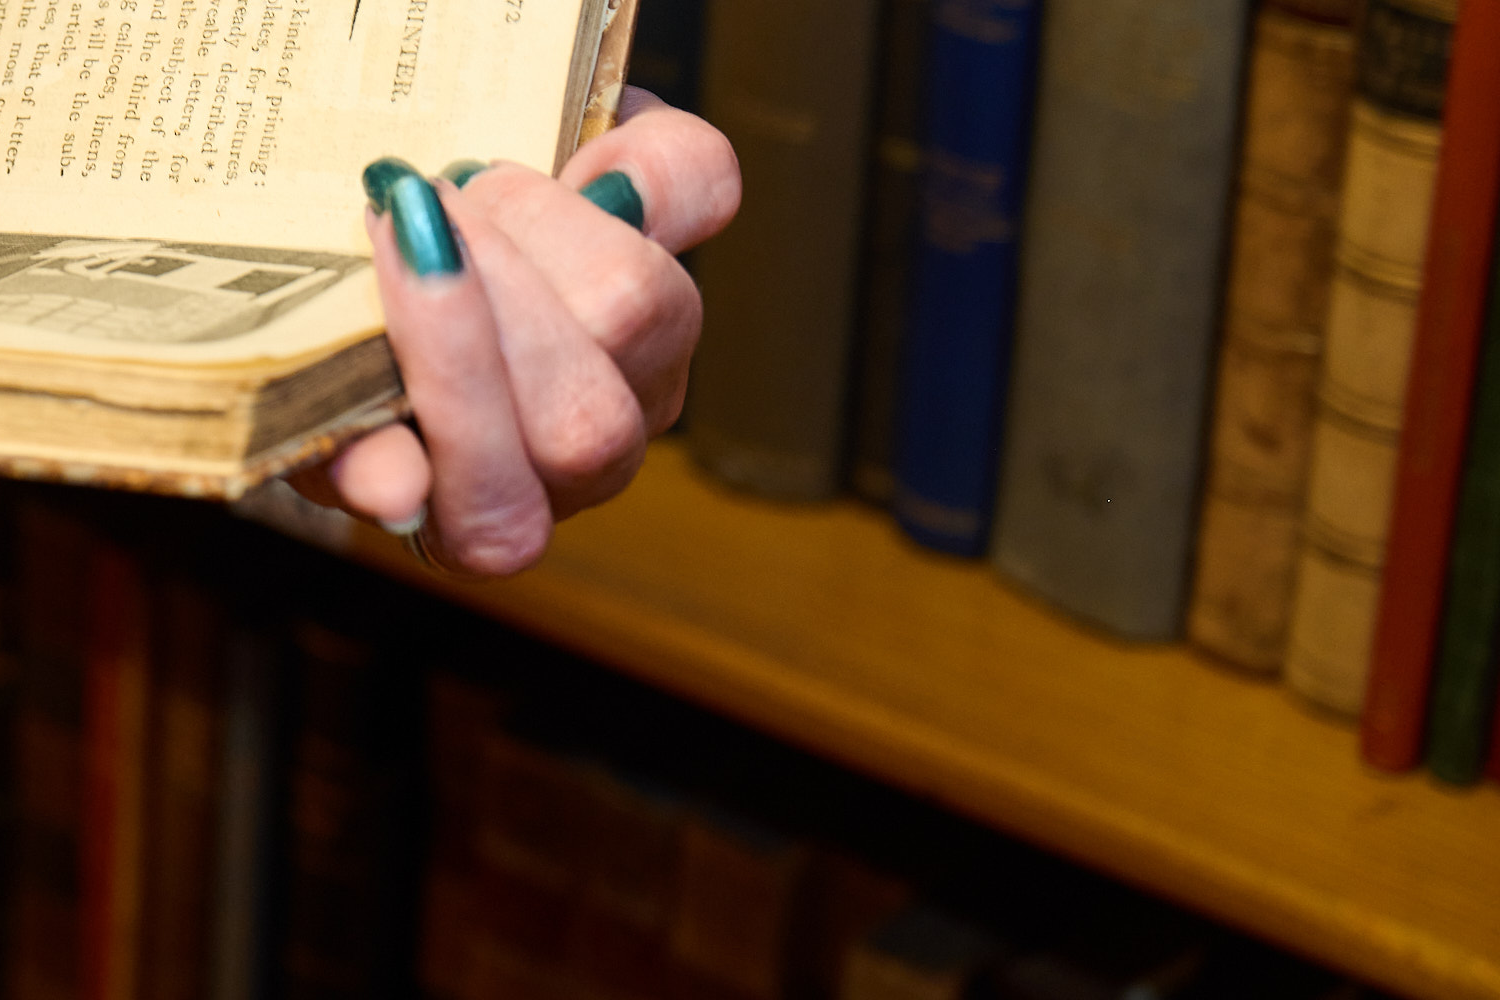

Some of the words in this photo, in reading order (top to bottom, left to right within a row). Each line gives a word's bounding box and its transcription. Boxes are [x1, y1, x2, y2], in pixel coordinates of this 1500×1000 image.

[87, 18, 106, 49] will
[177, 0, 197, 29] the
[282, 8, 310, 60] kinds
[57, 3, 82, 67] article.
[140, 32, 160, 62] the
[1, 43, 22, 86] most
[29, 43, 50, 79] that
[79, 59, 99, 80] be
[98, 23, 132, 99] calicoes,
[158, 37, 185, 104] subject
[246, 67, 267, 93] for
[276, 67, 292, 89] of
[22, 86, 36, 107] of
[69, 92, 89, 122] the
[124, 75, 149, 121] third
[174, 73, 209, 136] letters,
[5, 116, 31, 175] letter-
[81, 115, 113, 177] linens,
[151, 116, 166, 138] of
[222, 102, 255, 186] pictures,
[60, 133, 76, 177] sub-
[111, 134, 135, 180] from
[140, 151, 159, 181] the
[168, 155, 188, 183] for
